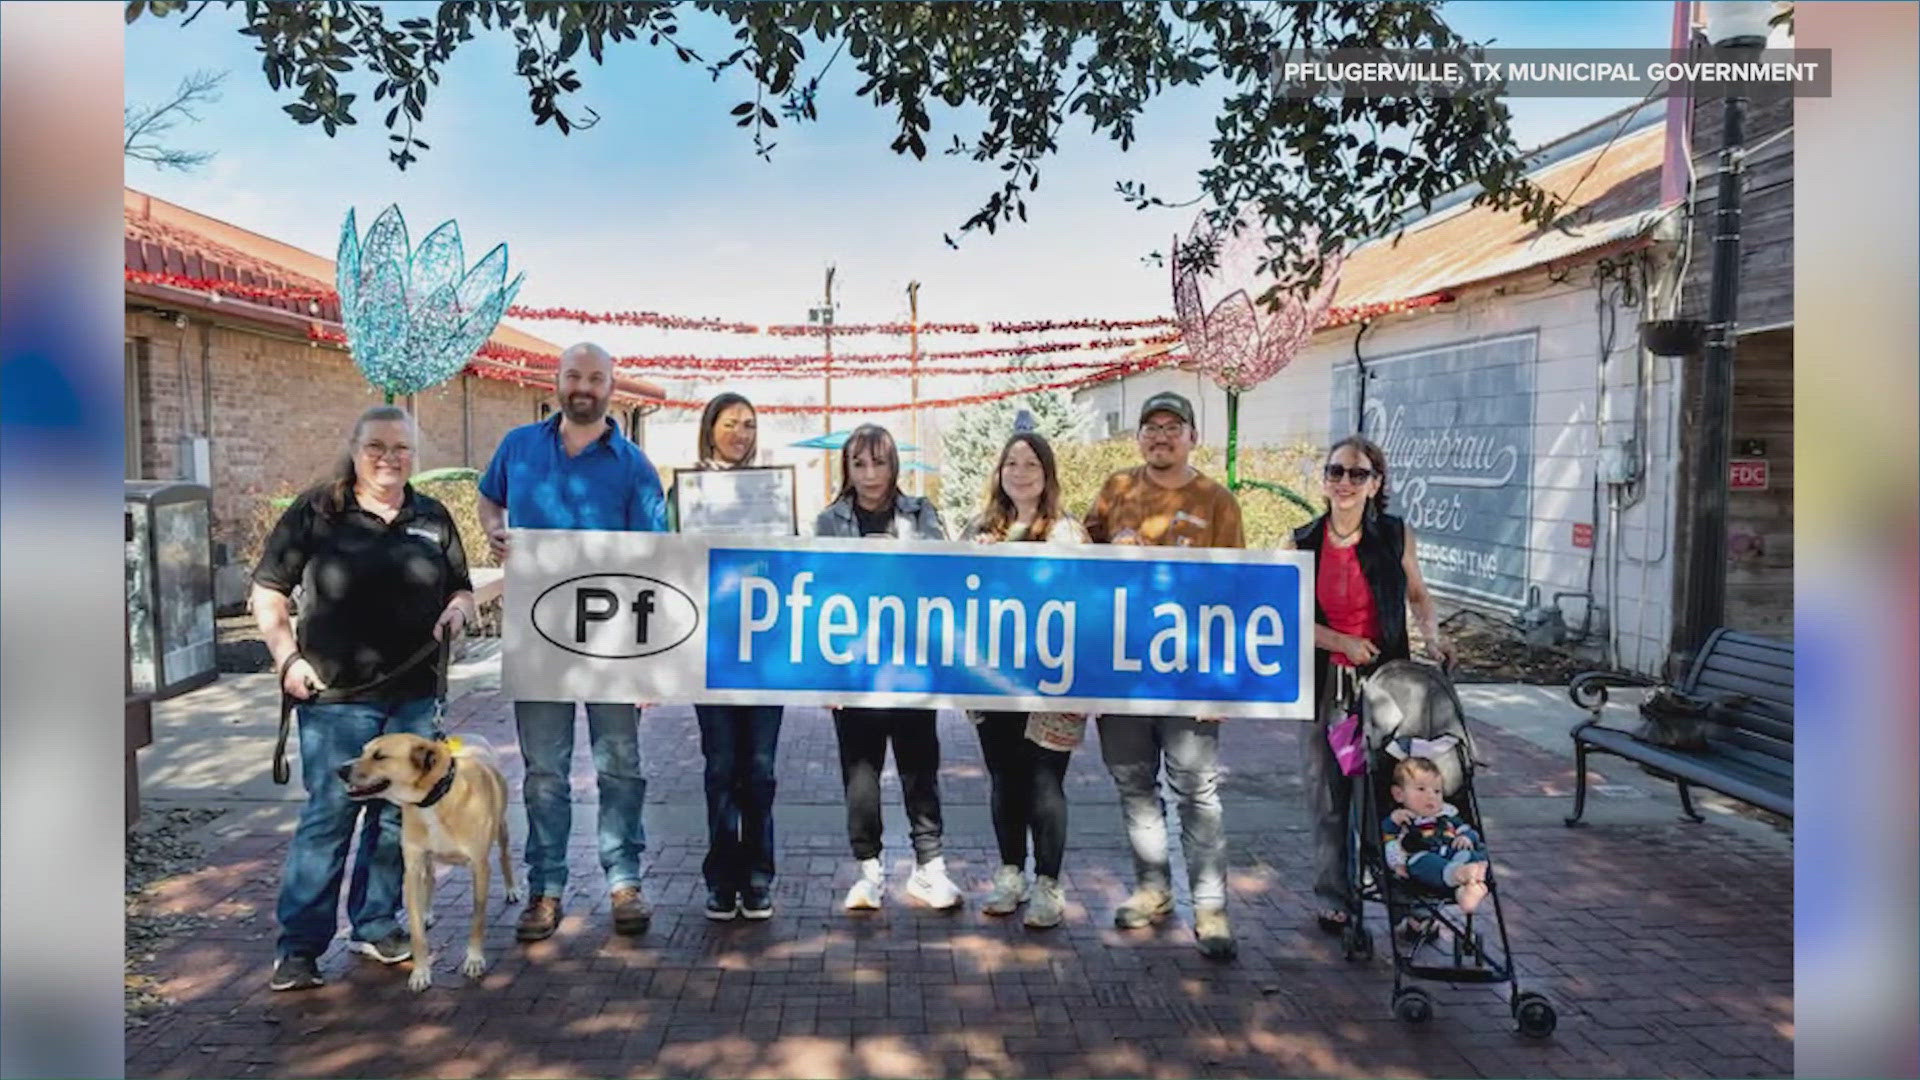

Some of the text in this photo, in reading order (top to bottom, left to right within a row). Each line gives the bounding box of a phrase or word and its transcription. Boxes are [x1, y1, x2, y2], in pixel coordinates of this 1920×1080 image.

[1730, 466, 1765, 484] FDC
[1401, 477, 1468, 532] Beer
[576, 587, 654, 645] Pf
[738, 571, 1285, 696] Pfenning Lane
